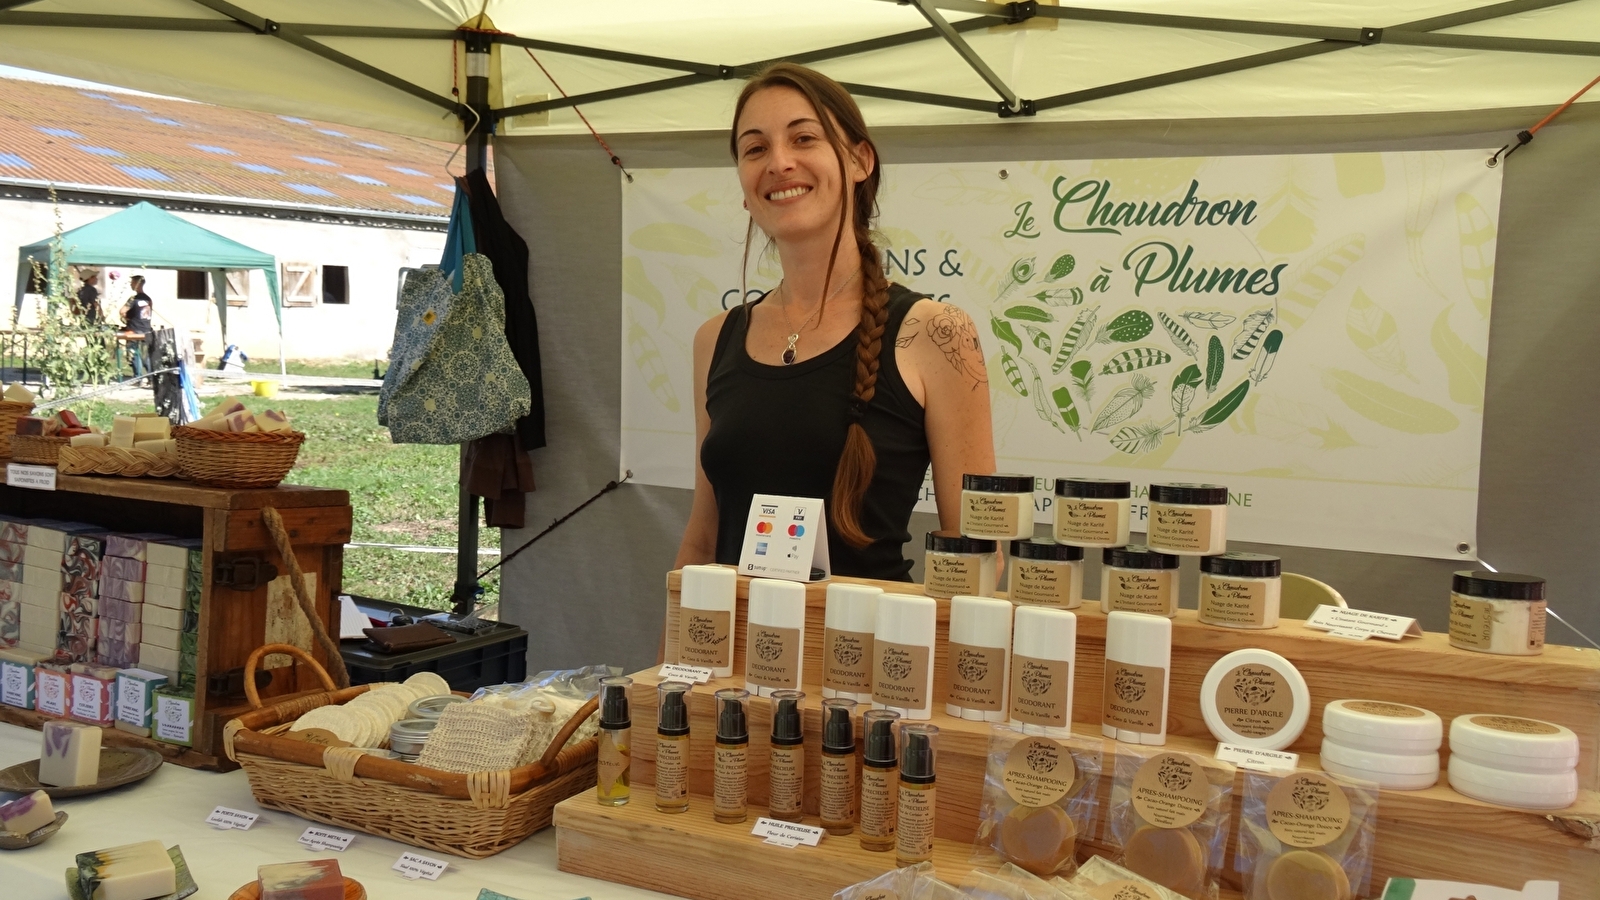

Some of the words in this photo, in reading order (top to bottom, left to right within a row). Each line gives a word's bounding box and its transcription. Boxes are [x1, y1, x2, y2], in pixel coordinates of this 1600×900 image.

[1003, 201, 1040, 238] Le
[1052, 175, 1257, 236] Chaudron
[938, 249, 963, 277] &
[1090, 266, 1113, 292] à
[1123, 241, 1288, 297] Plumes
[685, 646, 718, 656] DEODORANT
[672, 666, 702, 674] DEODORANT
[751, 663, 787, 673] DEODORANT
[829, 668, 865, 678] DEODORANT
[878, 682, 915, 693] DEODORANT
[953, 683, 991, 694] DEODORANT
[1017, 697, 1056, 709] DEODORANT
[1109, 703, 1149, 716] DEODORANT
[1224, 707, 1248, 716] PIERRE
[1250, 709, 1283, 718] D'ARGILE
[1233, 747, 1253, 755] PIERRE
[1255, 751, 1283, 759] D'ARGILE
[1007, 770, 1067, 787] APRES-SHAMPOOING
[1137, 787, 1203, 806] APRES-SHAMPOOING
[1272, 810, 1343, 824] APRES-SHAMPOOING
[768, 821, 783, 829] HUILE
[784, 825, 812, 834] PRECIEUSE
